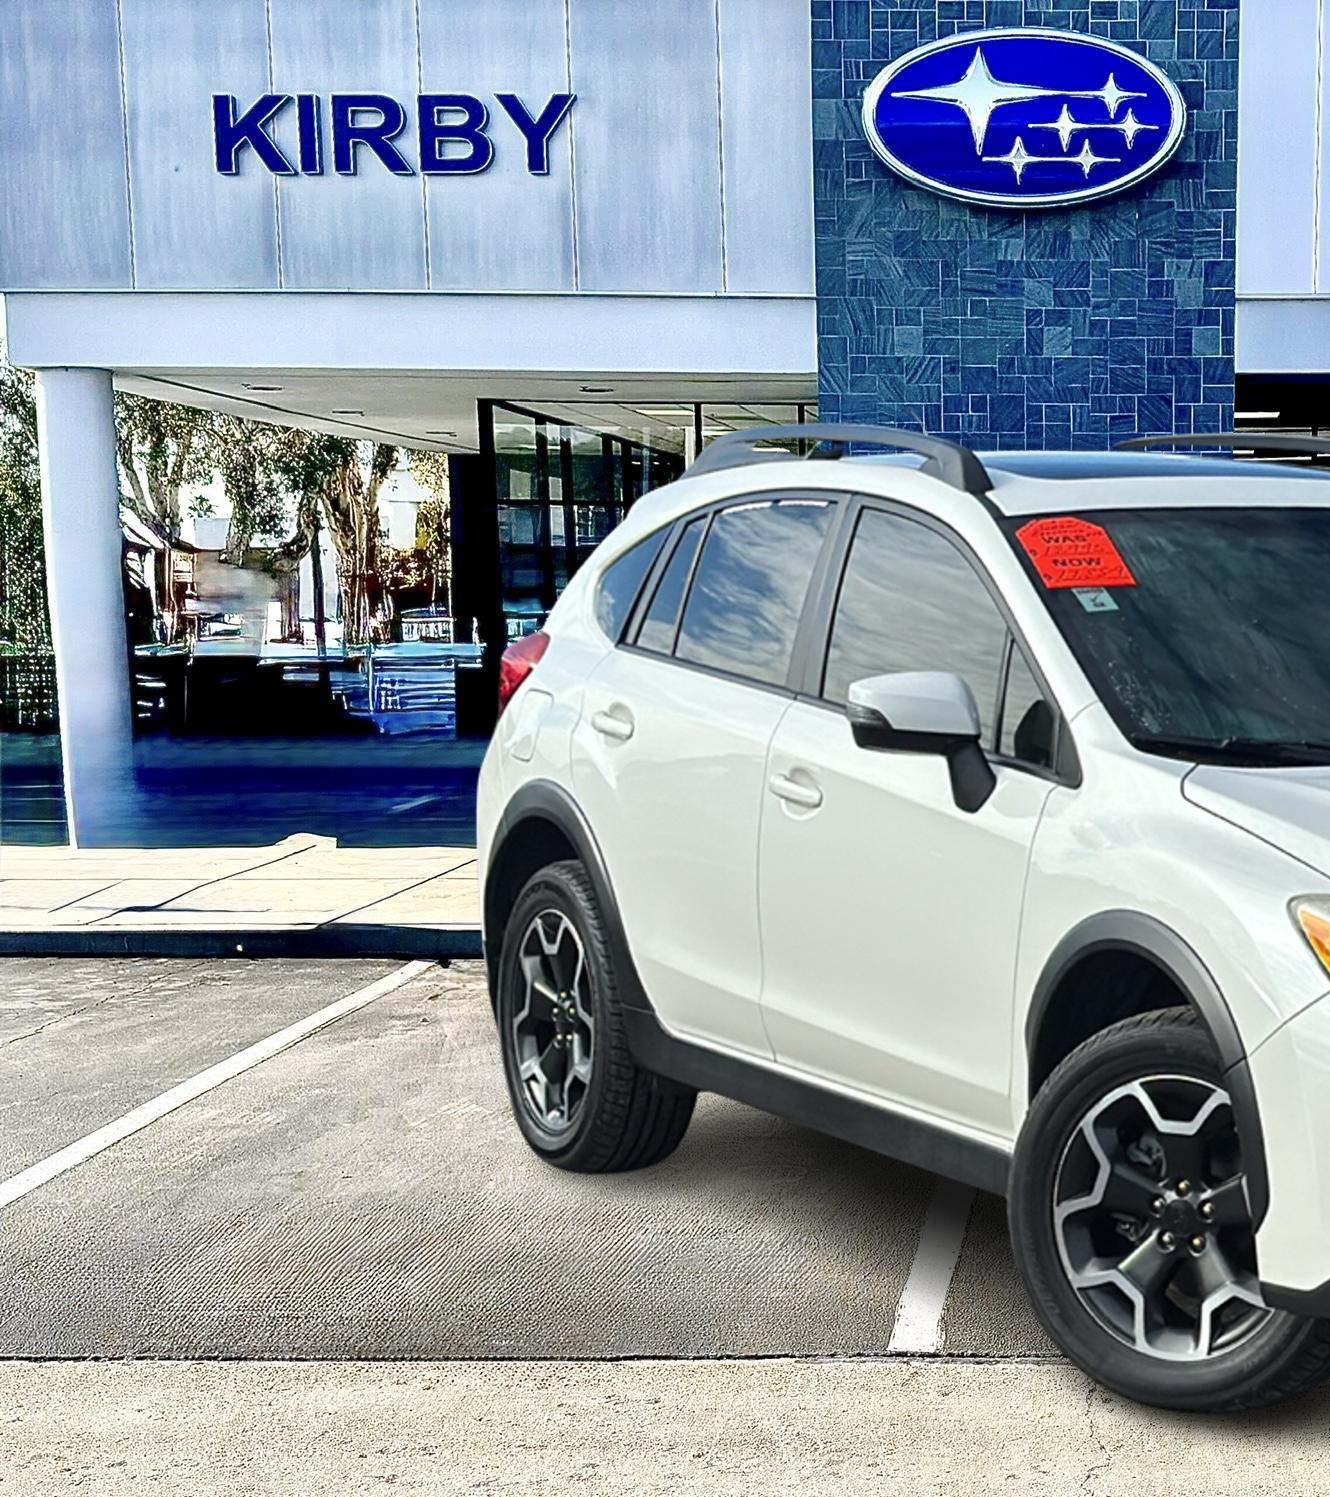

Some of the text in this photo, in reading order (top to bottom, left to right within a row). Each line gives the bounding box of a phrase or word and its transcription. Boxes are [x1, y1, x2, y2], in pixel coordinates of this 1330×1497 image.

[213, 94, 577, 177] KIRBY
[1041, 535, 1087, 544] WAS
[1052, 557, 1102, 566] NOW
